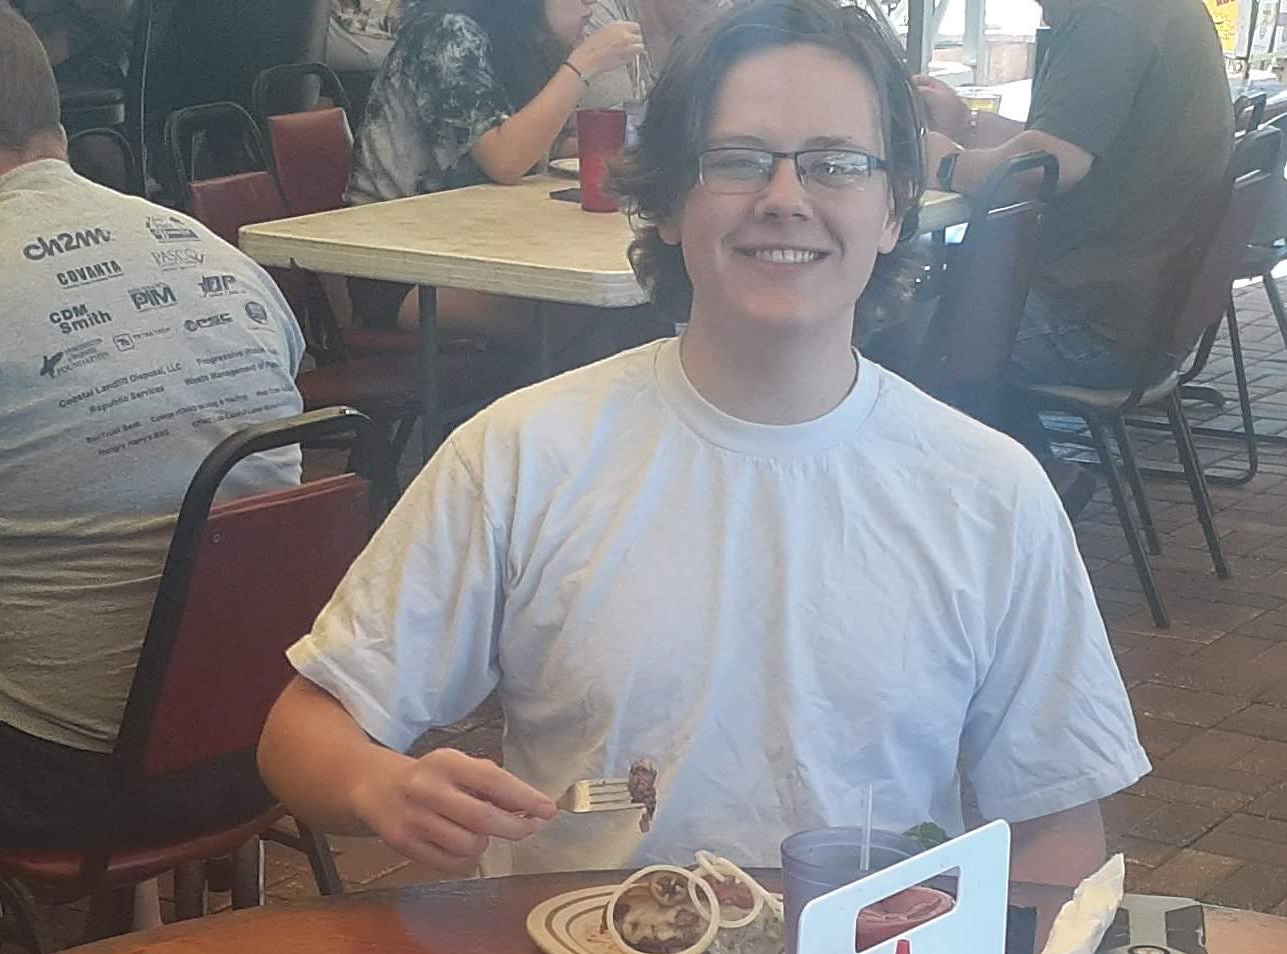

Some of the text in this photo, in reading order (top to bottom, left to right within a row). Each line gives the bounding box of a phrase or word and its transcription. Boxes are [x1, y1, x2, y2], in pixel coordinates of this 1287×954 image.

[57, 260, 123, 285] COVANTA
[49, 304, 88, 324] CDM
[59, 311, 112, 334] Smith
[166, 362, 182, 375] LLC
[130, 385, 164, 400] Services
